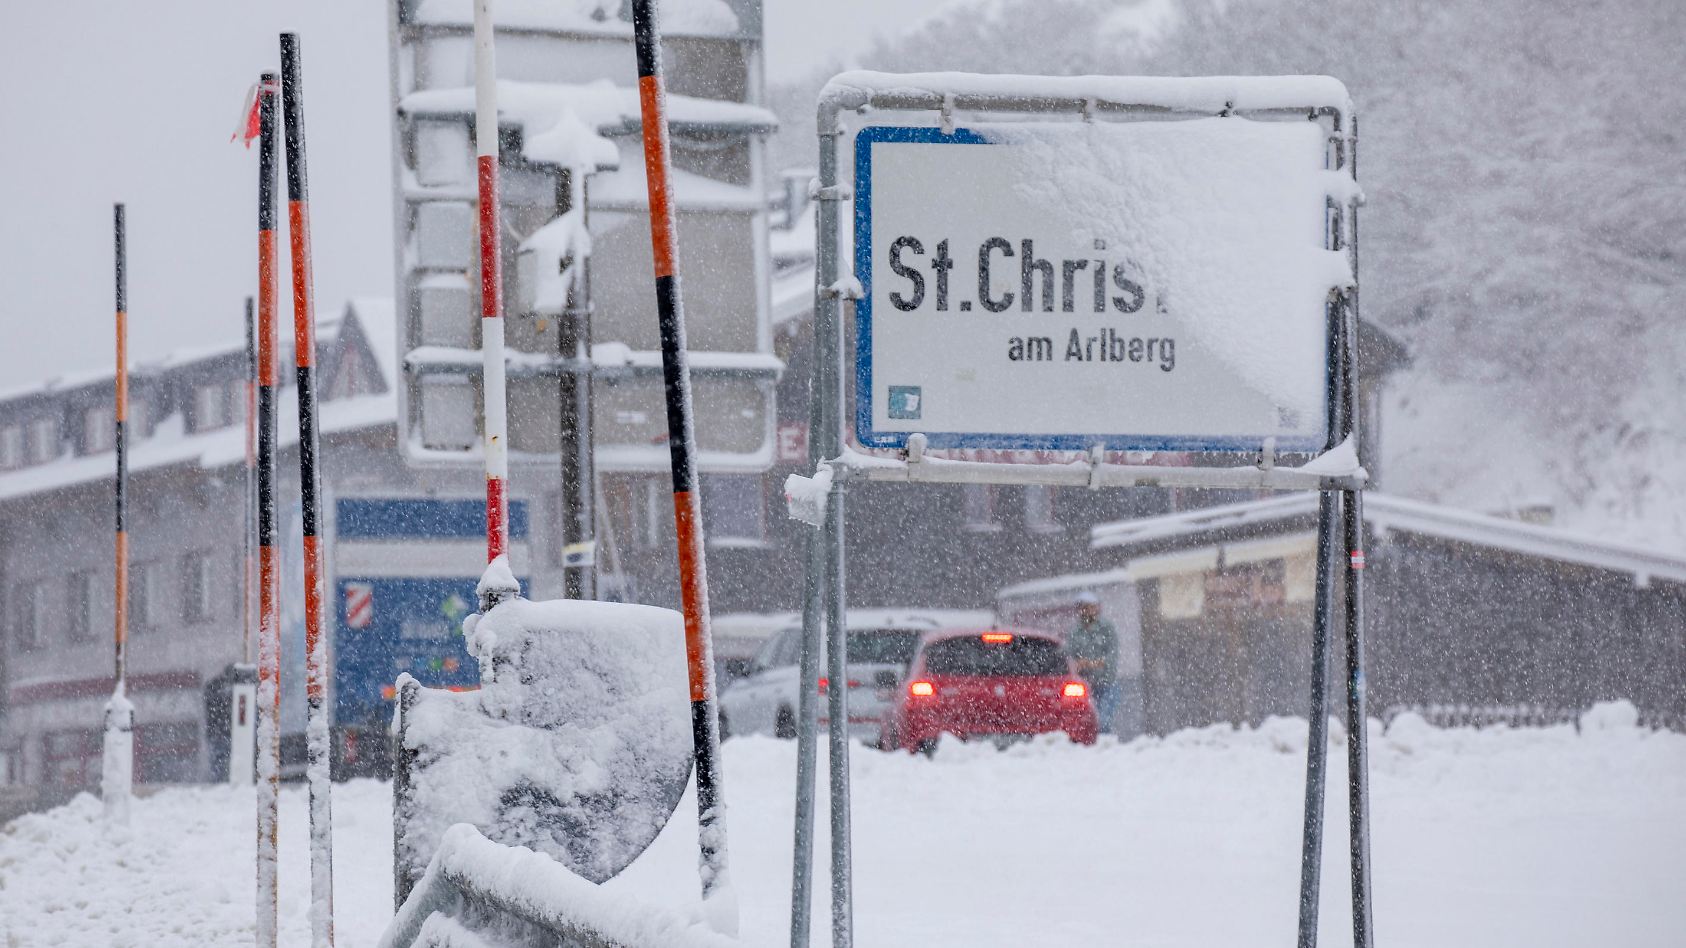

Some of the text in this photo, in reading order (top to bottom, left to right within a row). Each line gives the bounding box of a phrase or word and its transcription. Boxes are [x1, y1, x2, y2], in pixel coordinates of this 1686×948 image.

[889, 236, 1168, 313] St.Chris
[1008, 328, 1176, 372] am Arlberg
